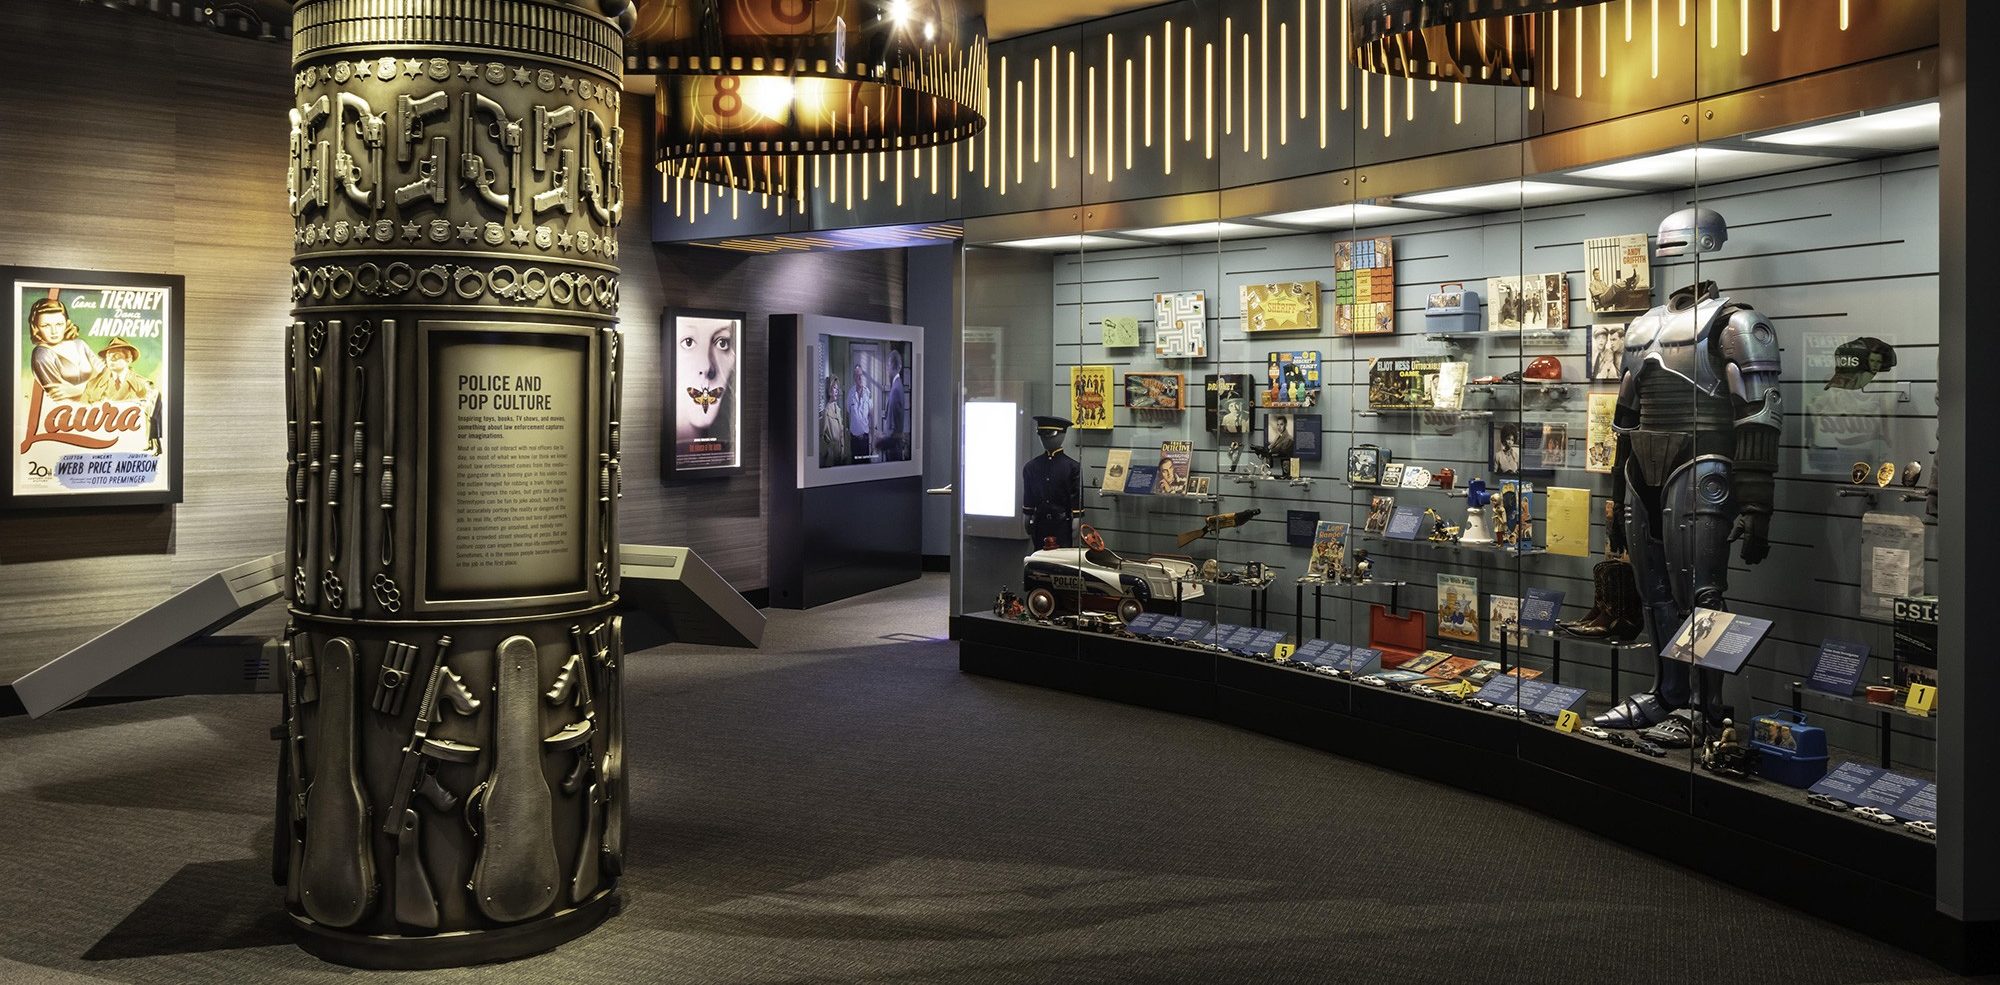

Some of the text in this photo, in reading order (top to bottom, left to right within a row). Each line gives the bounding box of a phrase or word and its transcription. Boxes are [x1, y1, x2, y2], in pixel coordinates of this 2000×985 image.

[712, 74, 742, 118] 8
[100, 290, 162, 310] TIERNEY
[114, 309, 141, 319] Dana
[88, 318, 162, 338] ANDREWS
[458, 375, 542, 392] POLICE AND
[458, 394, 552, 410] POP CULTURE
[58, 460, 158, 475] WEBB PRICE ANDERSON
[92, 476, 108, 485] OTTO
[108, 475, 145, 484] PREMINGER
[1280, 646, 1288, 658] 5
[1917, 688, 1926, 704] 1
[1562, 712, 1570, 728] 2
